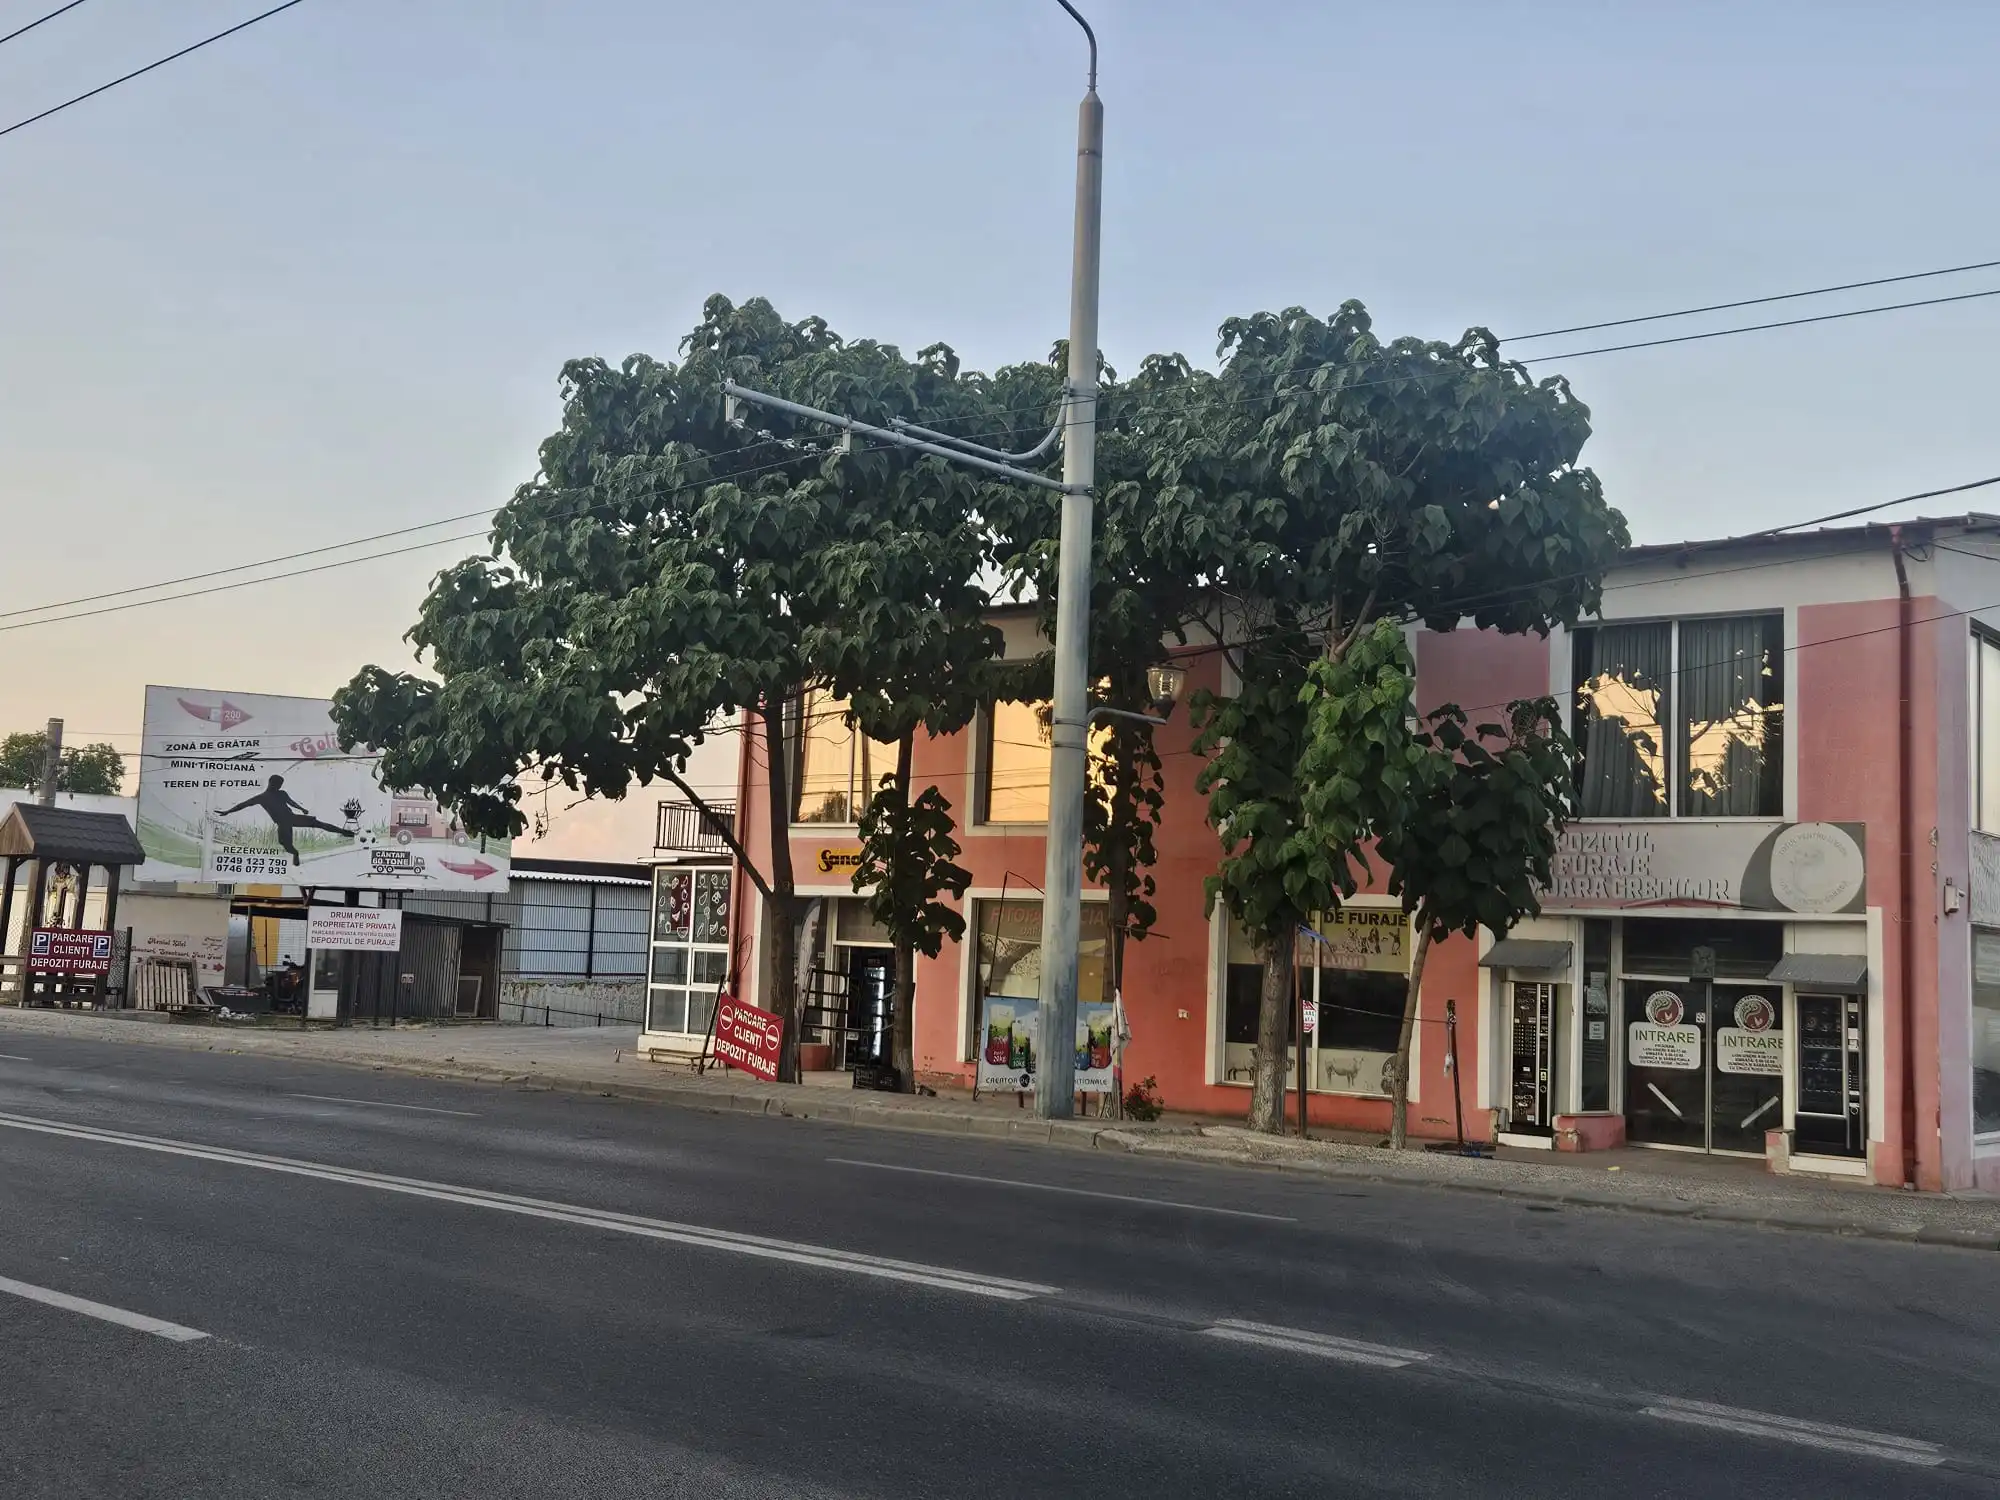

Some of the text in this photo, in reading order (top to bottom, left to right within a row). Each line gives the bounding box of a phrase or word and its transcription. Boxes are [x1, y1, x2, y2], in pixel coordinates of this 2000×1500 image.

[199, 742, 214, 750] DE
[163, 779, 261, 788] TEREN DE FOTBAL
[216, 856, 288, 867] 0749 123 790
[372, 857, 383, 865] 60
[818, 849, 862, 873] Sano
[216, 864, 287, 875] 0746 077 933
[330, 911, 381, 920] DRUM PRIVAT
[1323, 911, 1345, 925] DE
[1349, 912, 1409, 927] FURAJE
[312, 920, 364, 929] PROPRIETATE
[36, 933, 108, 949] P PARCARE P
[311, 936, 353, 945] DEPOZITUL
[366, 938, 396, 946] FURAJE
[31, 957, 109, 970] DEPOZIT FURAJE
[734, 1007, 768, 1031] PARCARE
[1635, 1029, 1696, 1044] INTRARE
[1723, 1035, 1784, 1049] INTRARE
[715, 1037, 777, 1077] DEPOZIT FURAJE
